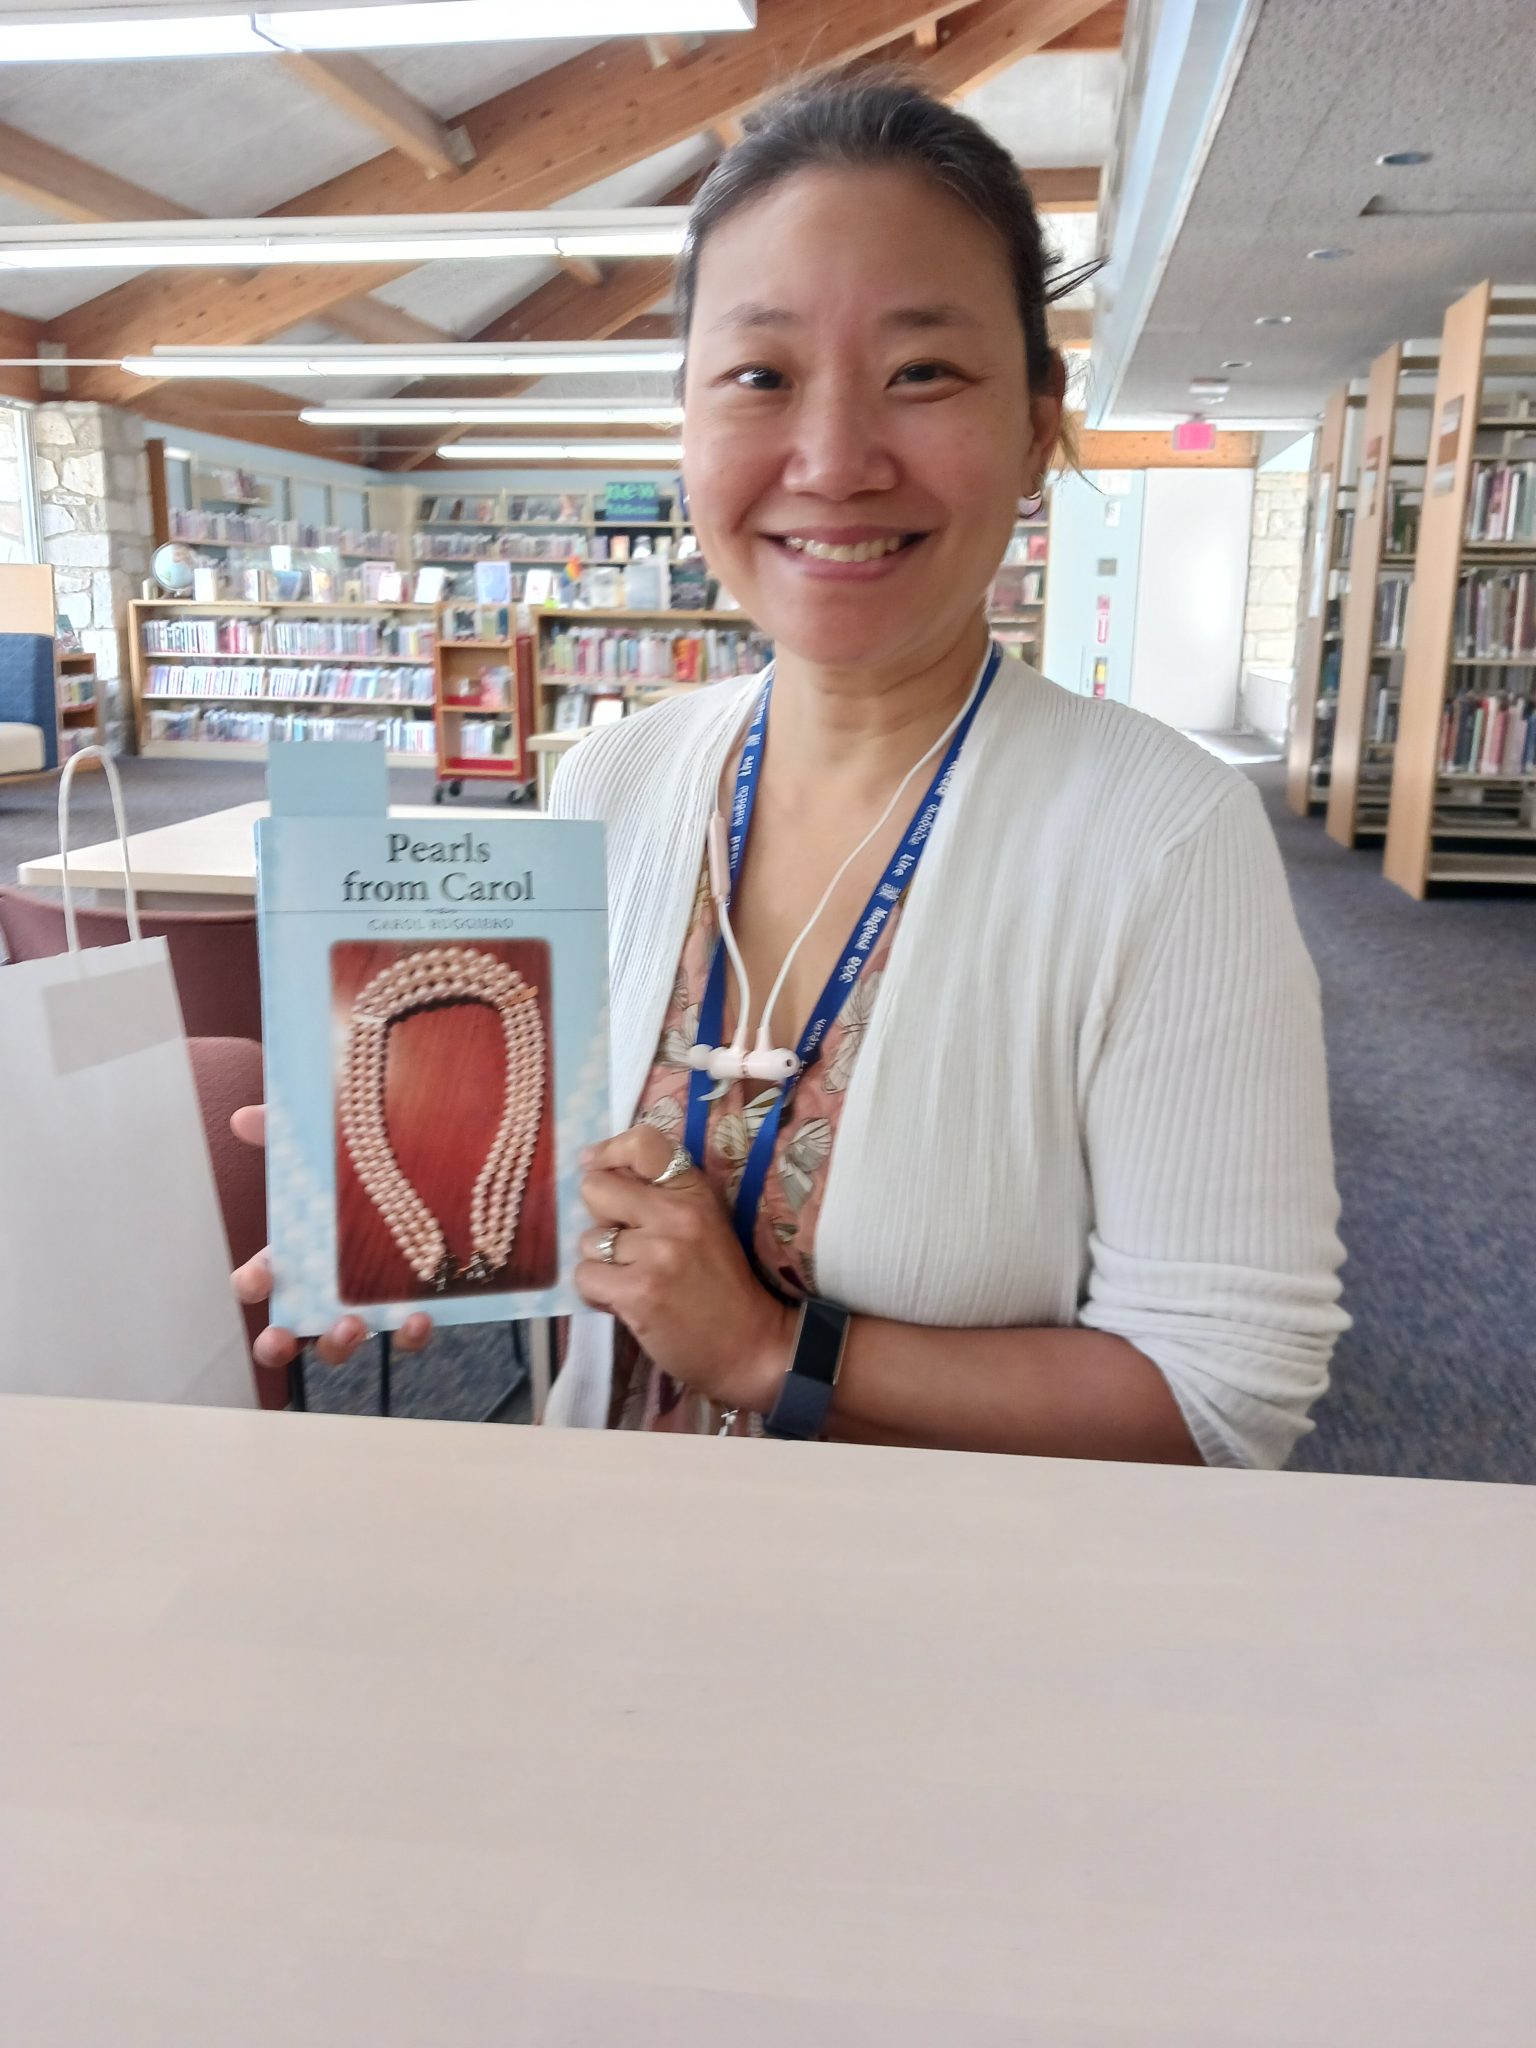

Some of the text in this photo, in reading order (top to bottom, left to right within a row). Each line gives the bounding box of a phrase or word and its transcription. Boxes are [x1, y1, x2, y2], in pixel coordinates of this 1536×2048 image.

[385, 832, 491, 864] Pearls
[891, 853, 915, 877] Lire
[341, 869, 536, 902] from Carol
[367, 917, 425, 931] CAROL
